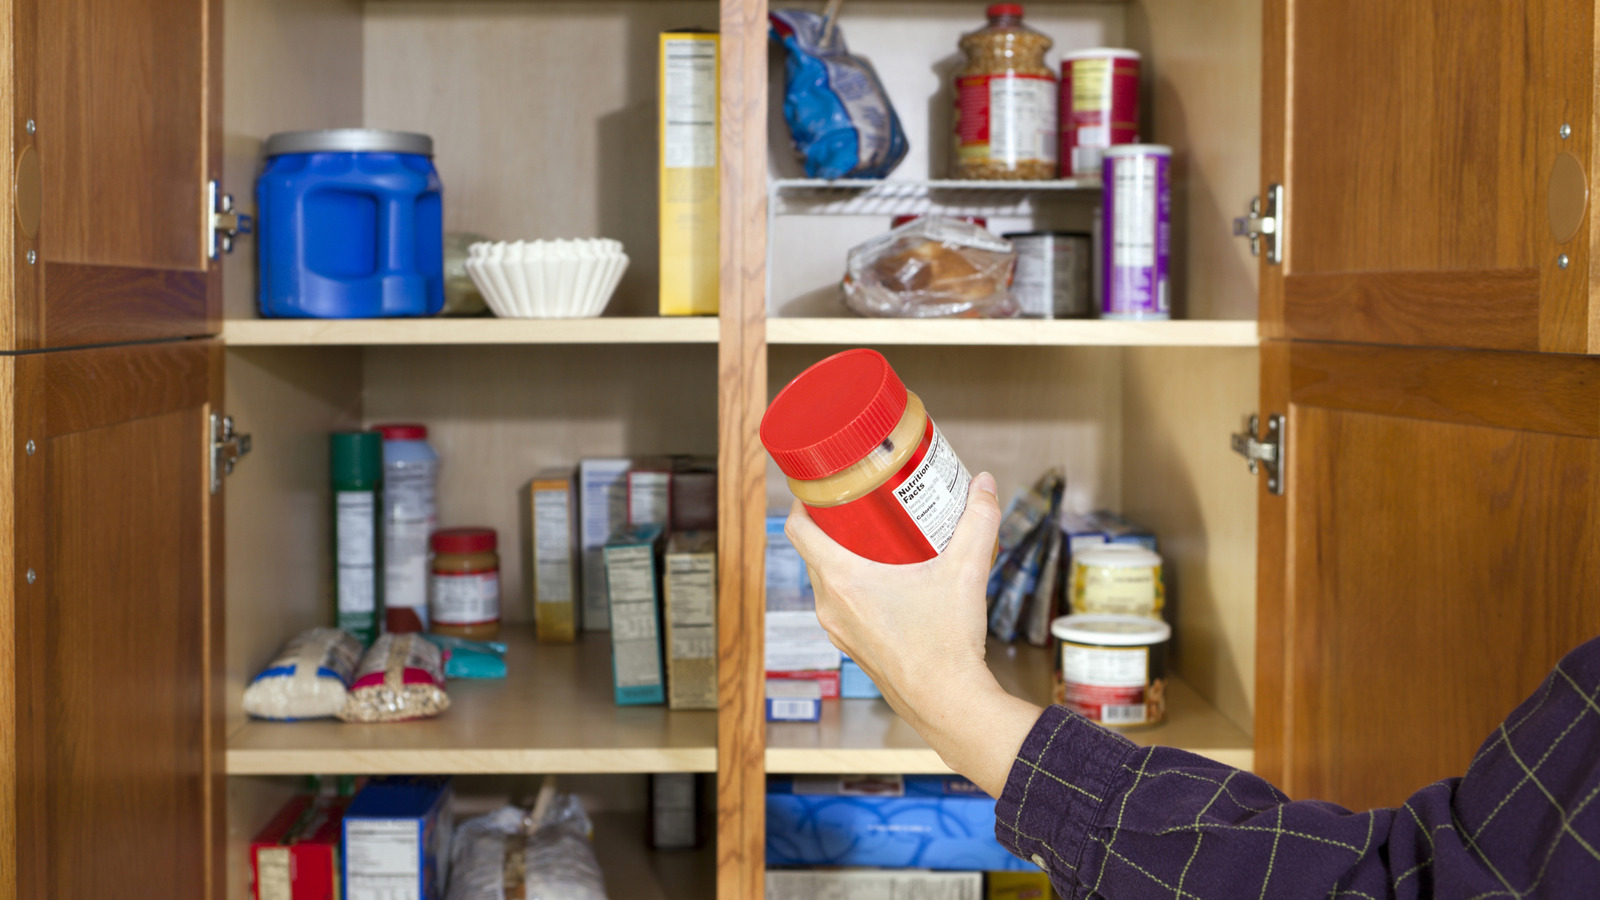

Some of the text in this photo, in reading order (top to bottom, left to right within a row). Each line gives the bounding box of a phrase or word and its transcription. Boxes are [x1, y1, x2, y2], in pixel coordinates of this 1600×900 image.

[898, 463, 929, 497] Nutrition
[903, 482, 924, 503] Facts
[916, 500, 935, 520] Calories
